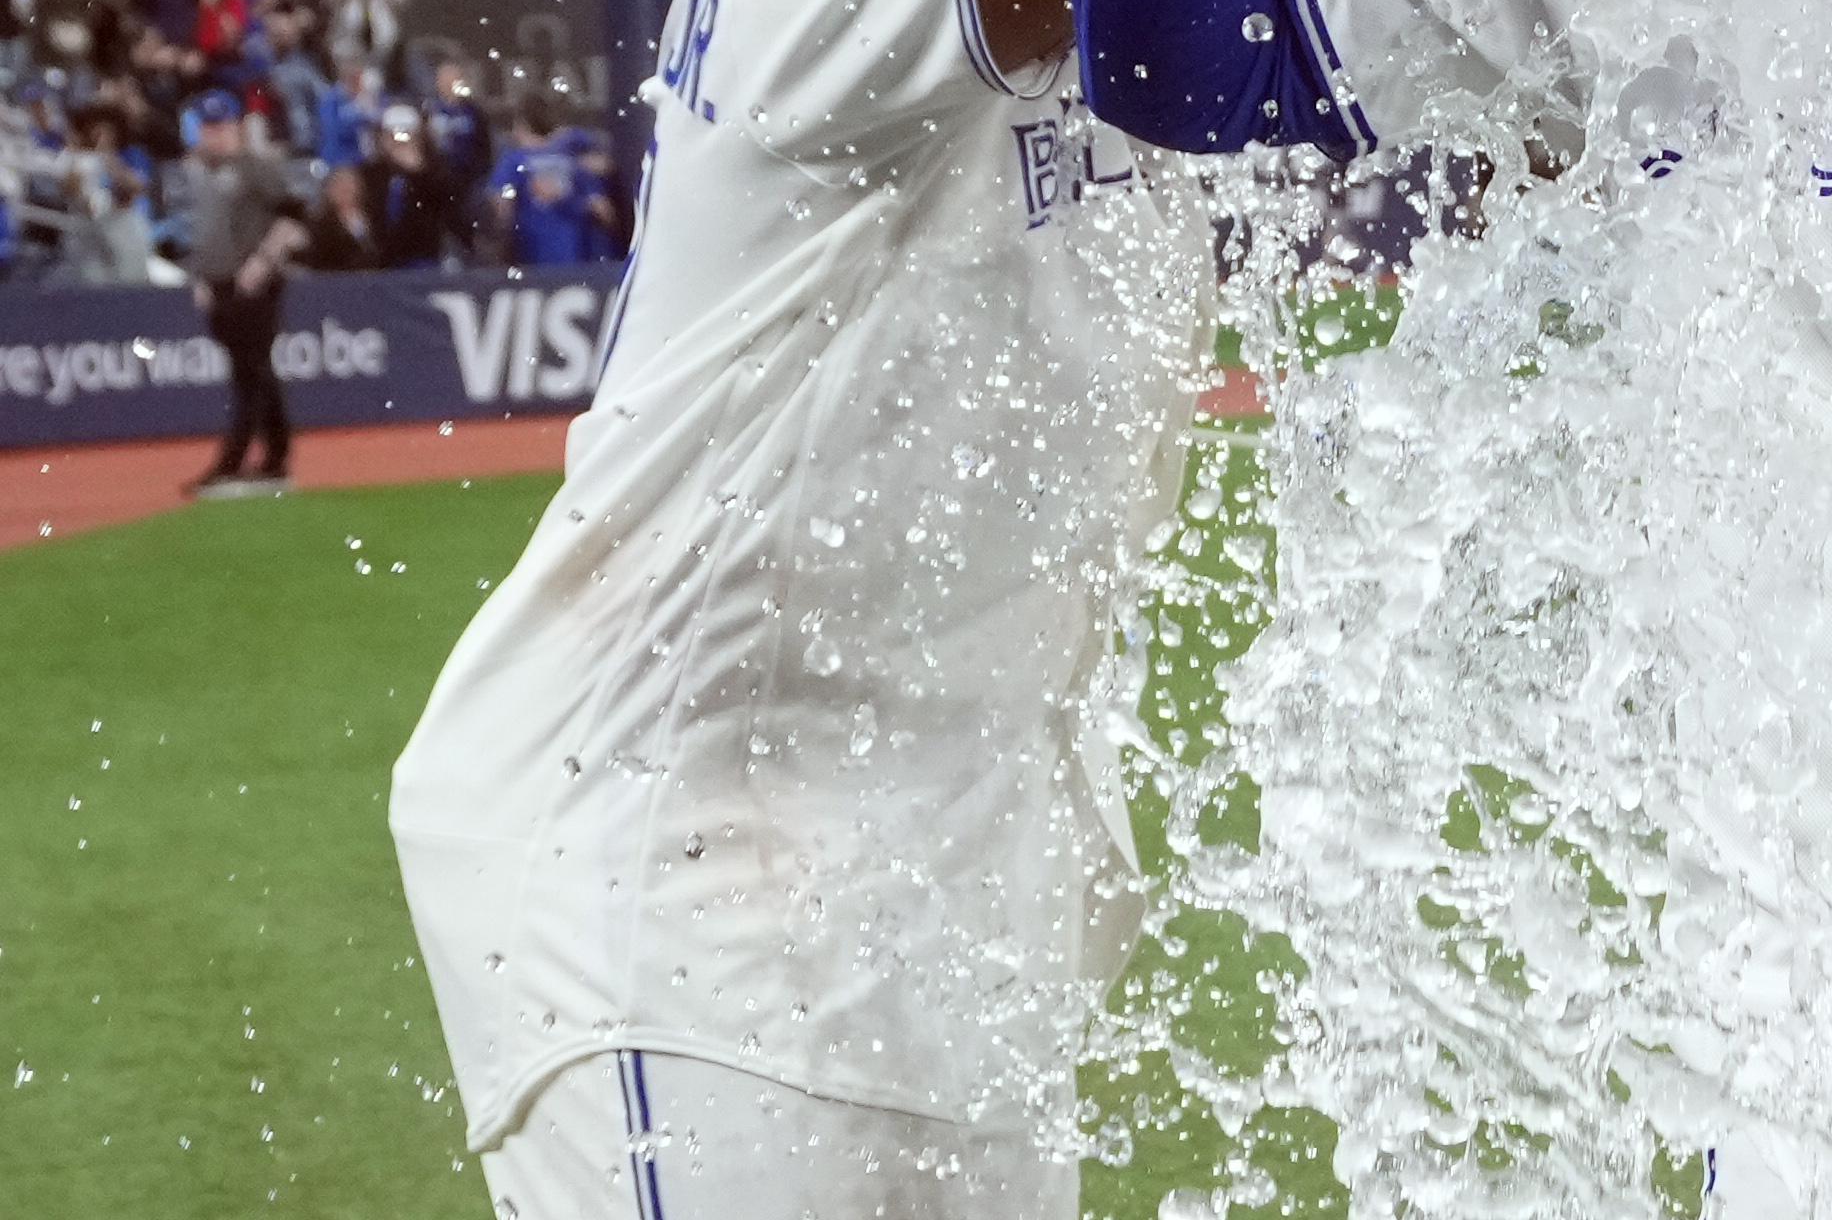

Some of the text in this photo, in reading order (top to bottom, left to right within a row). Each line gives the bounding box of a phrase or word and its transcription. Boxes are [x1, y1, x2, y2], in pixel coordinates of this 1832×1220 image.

[43, 340, 143, 407] you
[143, 336, 234, 386] wan
[322, 317, 389, 377] be
